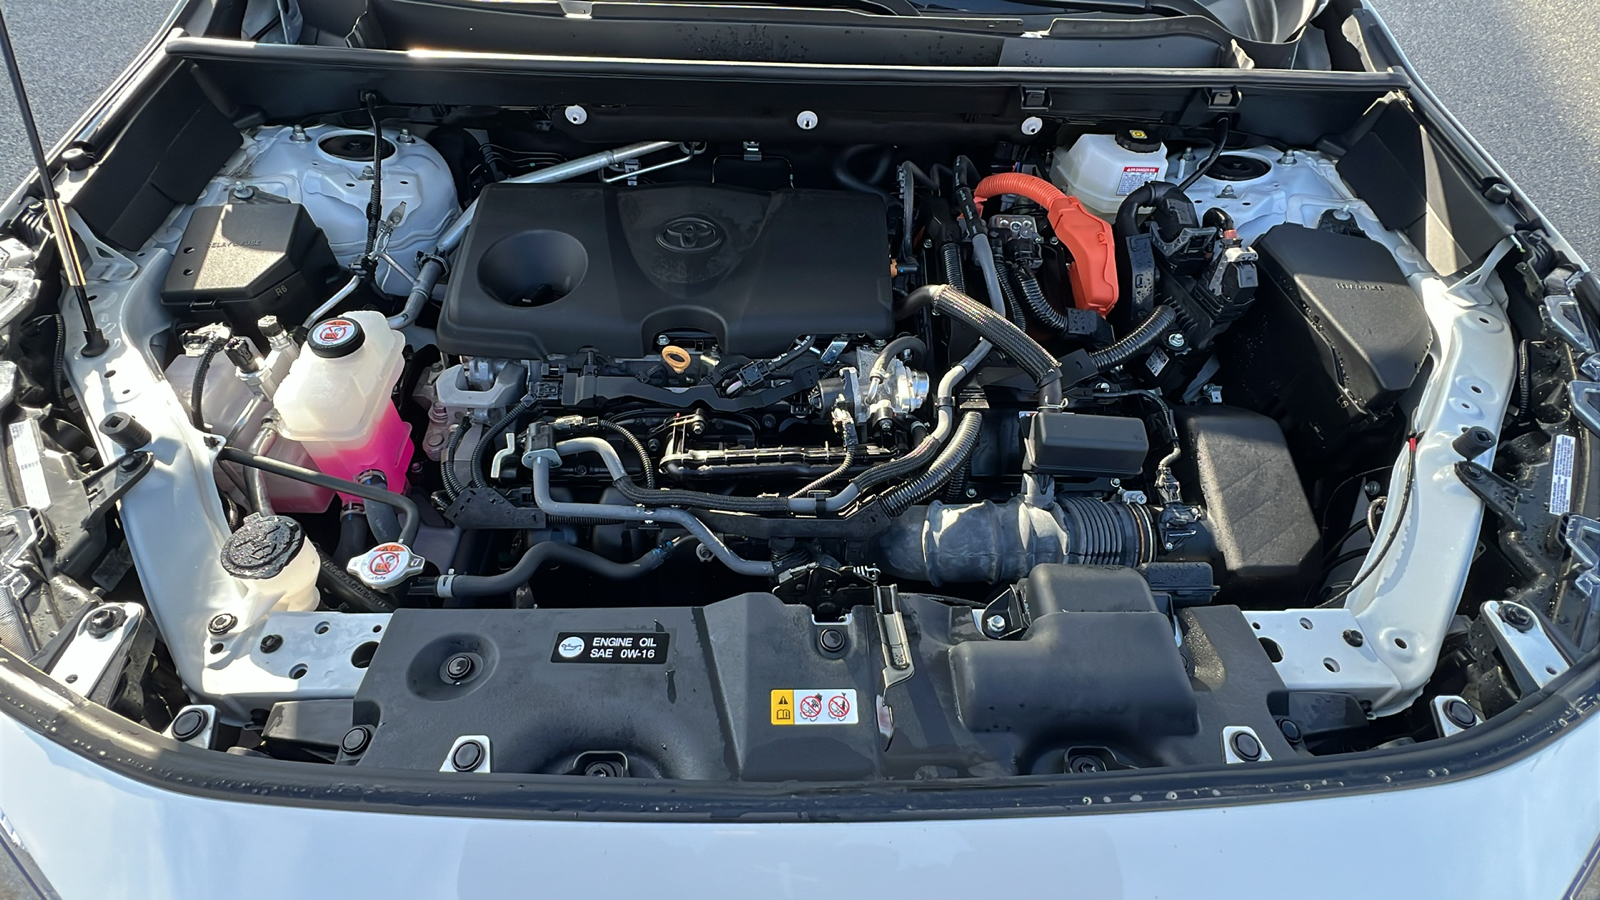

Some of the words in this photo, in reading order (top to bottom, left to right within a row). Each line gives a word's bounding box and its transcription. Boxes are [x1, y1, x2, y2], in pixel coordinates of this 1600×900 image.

[275, 285, 288, 296] R6
[592, 637, 633, 647] ENGINE
[639, 637, 657, 647] OIL
[589, 648, 613, 658] SAE
[620, 649, 655, 659] 0W-16
